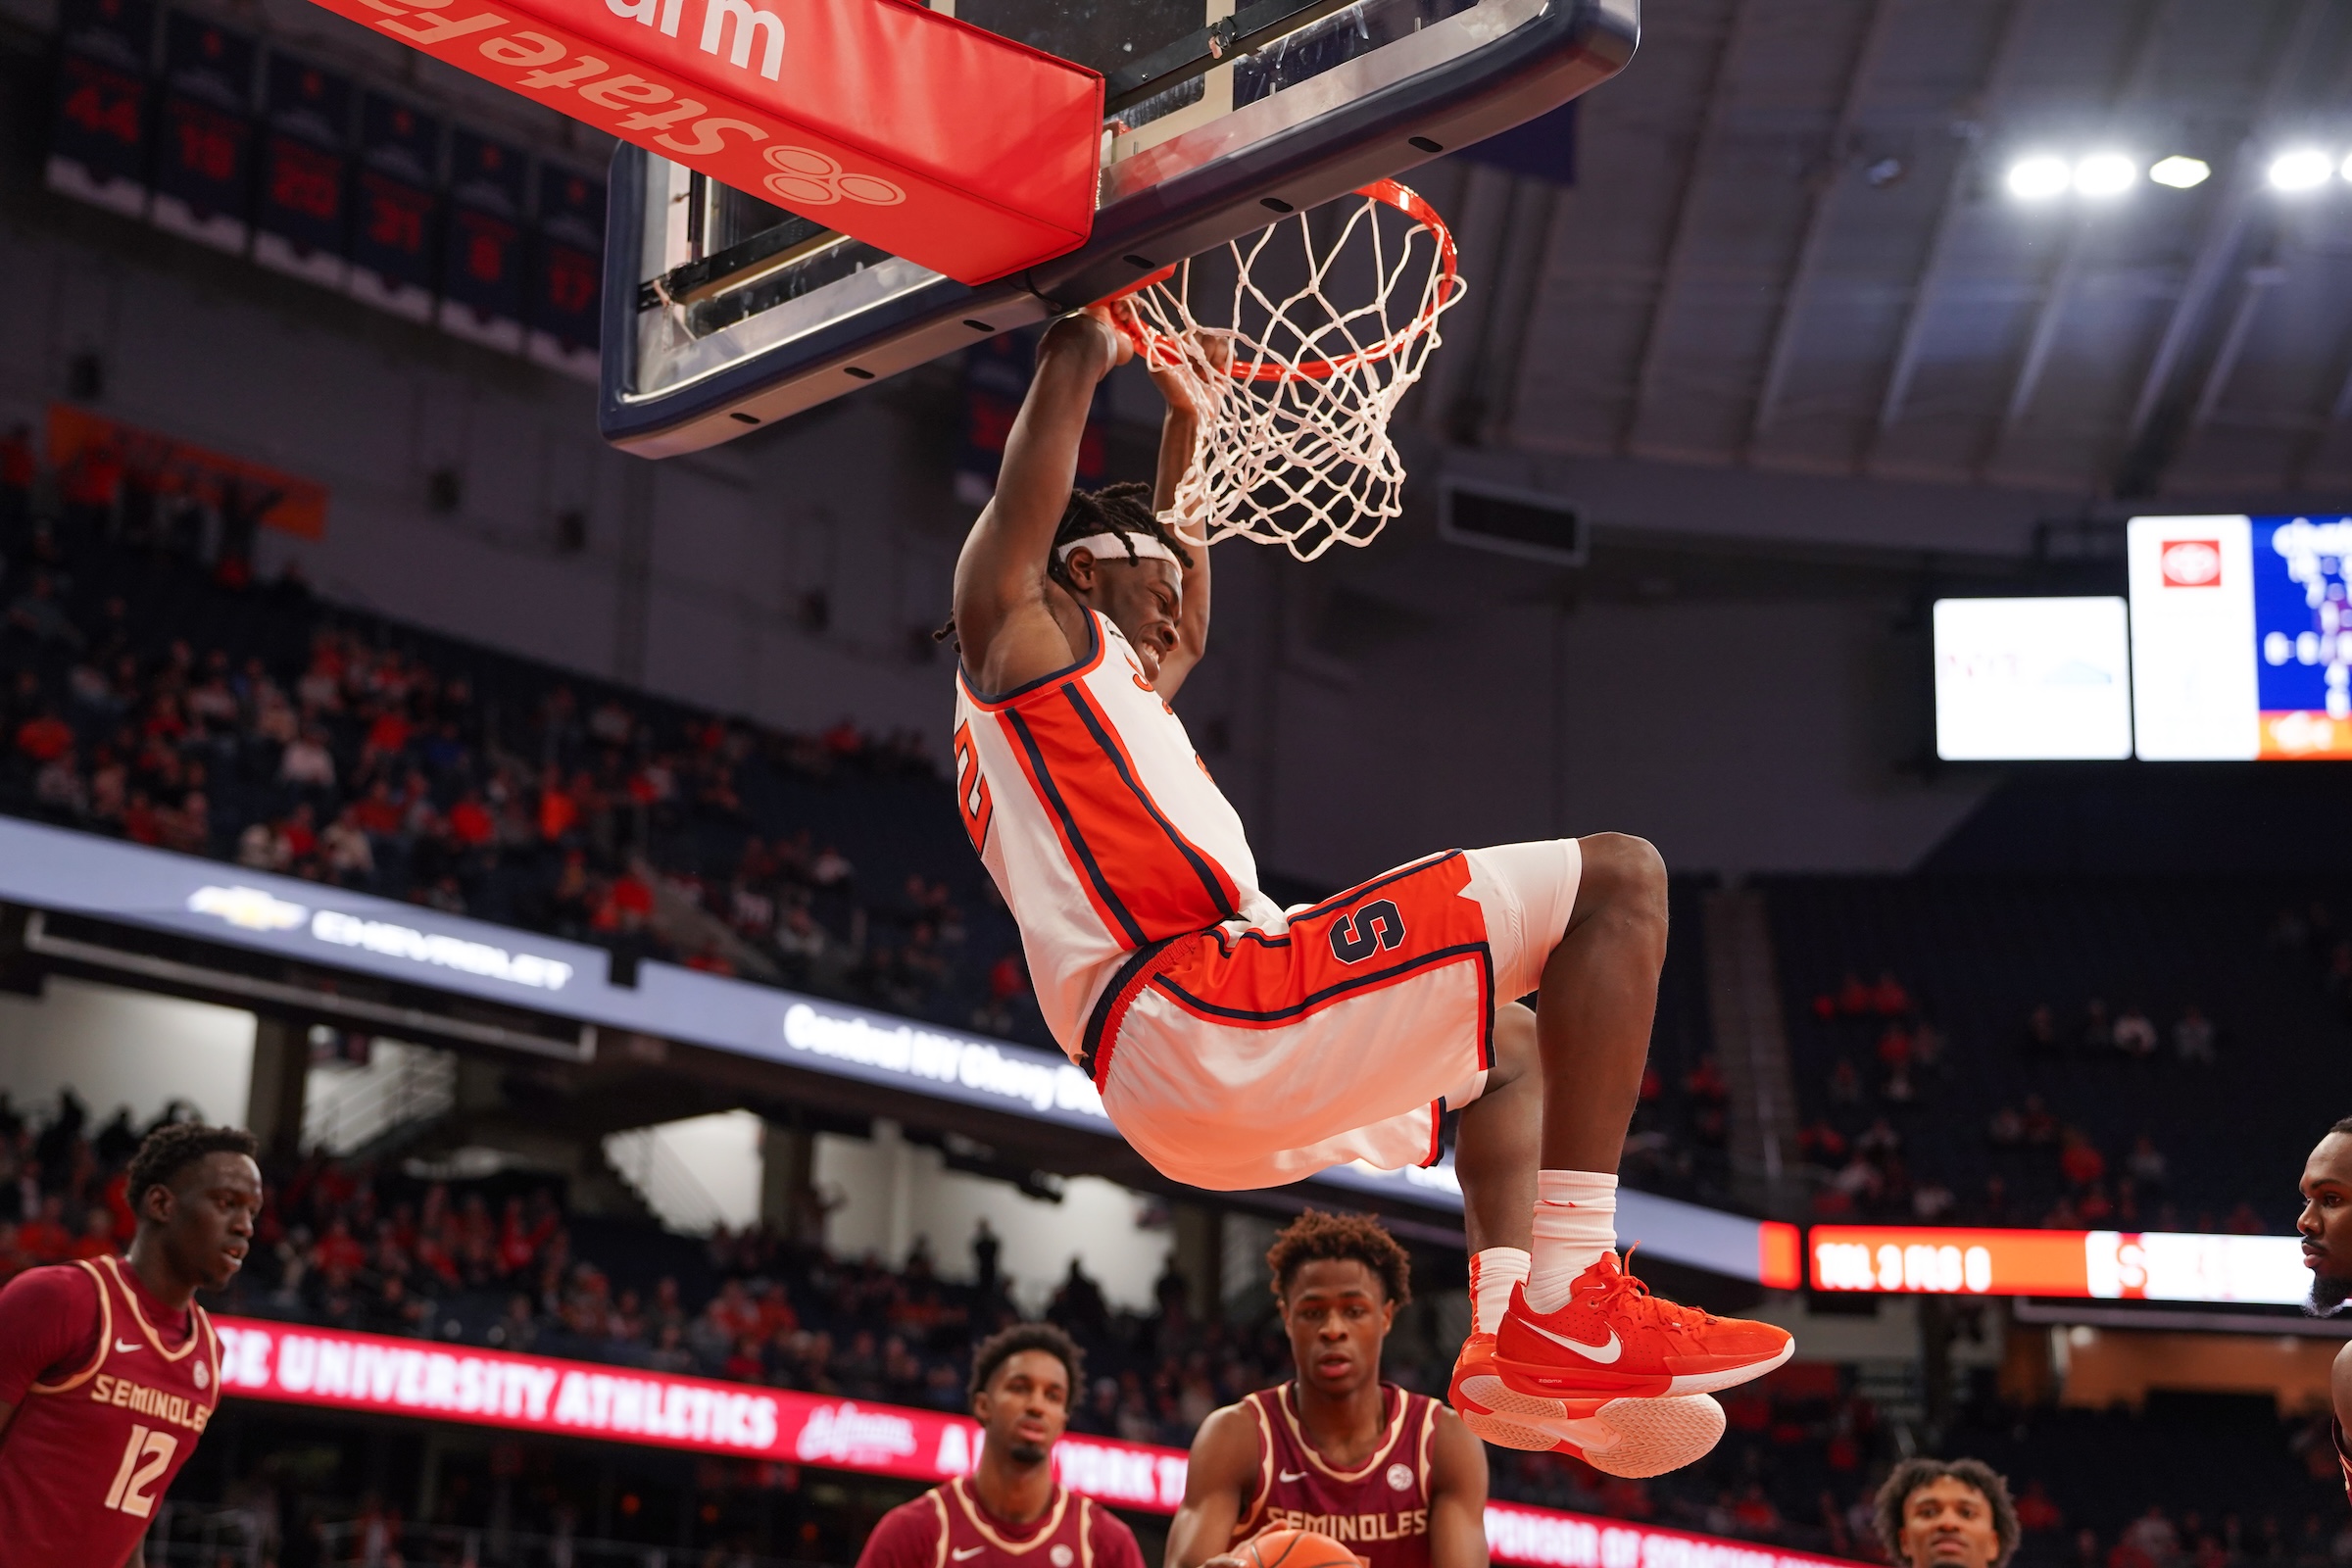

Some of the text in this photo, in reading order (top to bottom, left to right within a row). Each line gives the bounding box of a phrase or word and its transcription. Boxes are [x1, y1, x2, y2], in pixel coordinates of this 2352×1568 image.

[1328, 899, 1406, 965] S
[90, 1373, 212, 1433] SEMINOLE
[276, 1334, 559, 1422] UNIVERSITY
[554, 1370, 779, 1450] ATHLETICS
[105, 1424, 178, 1518] 12
